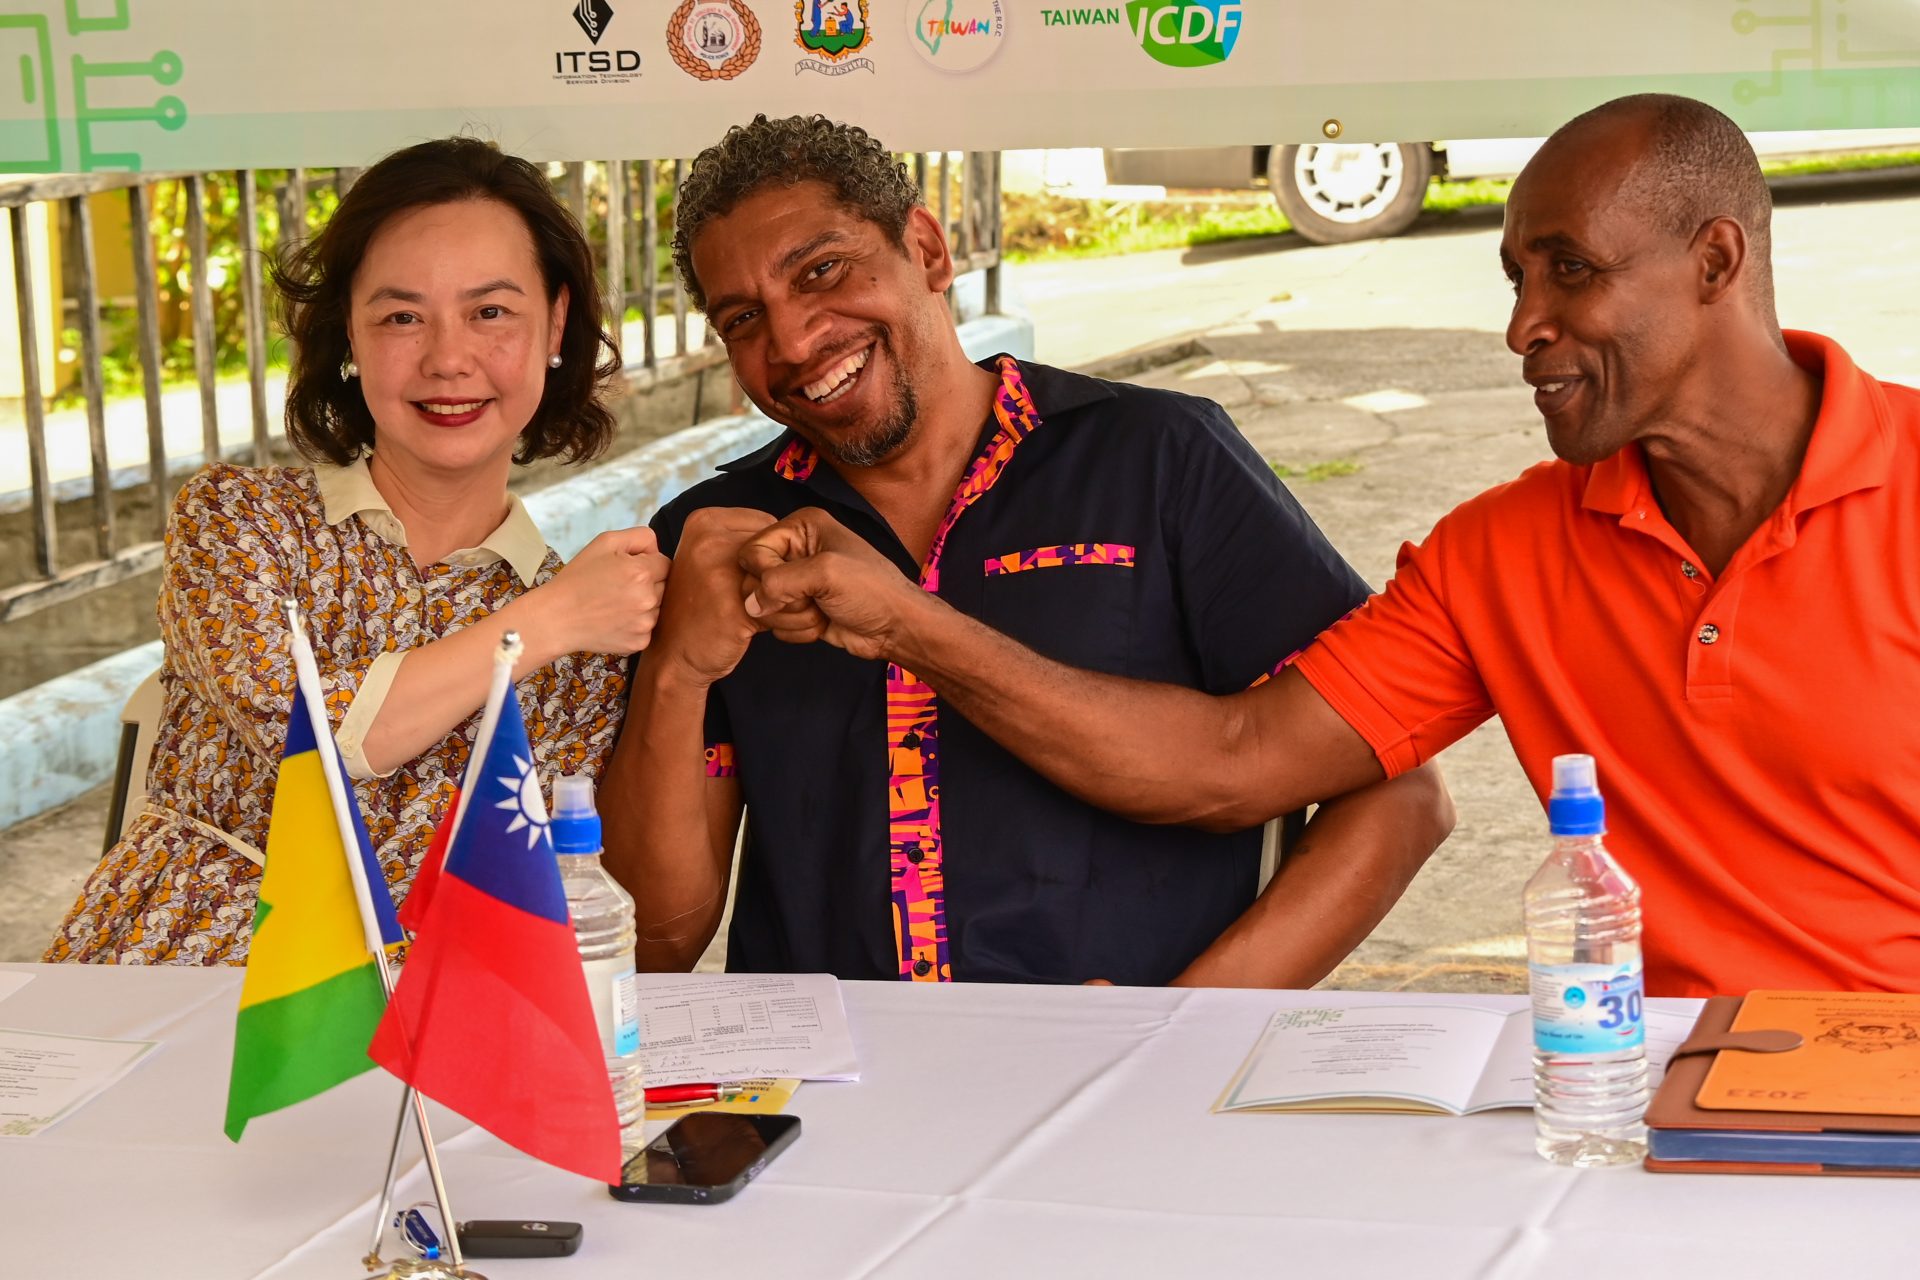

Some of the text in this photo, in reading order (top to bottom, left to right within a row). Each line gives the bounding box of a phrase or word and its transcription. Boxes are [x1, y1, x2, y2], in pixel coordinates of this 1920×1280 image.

[928, 17, 990, 37] TAIWAN
[1040, 4, 1242, 45] TAIWAN ICDF
[555, 50, 641, 73] ITSD
[799, 60, 817, 70] PAX
[818, 64, 829, 74] ET
[1597, 989, 1641, 1029] 30
[1726, 1088, 1810, 1100] 2023
